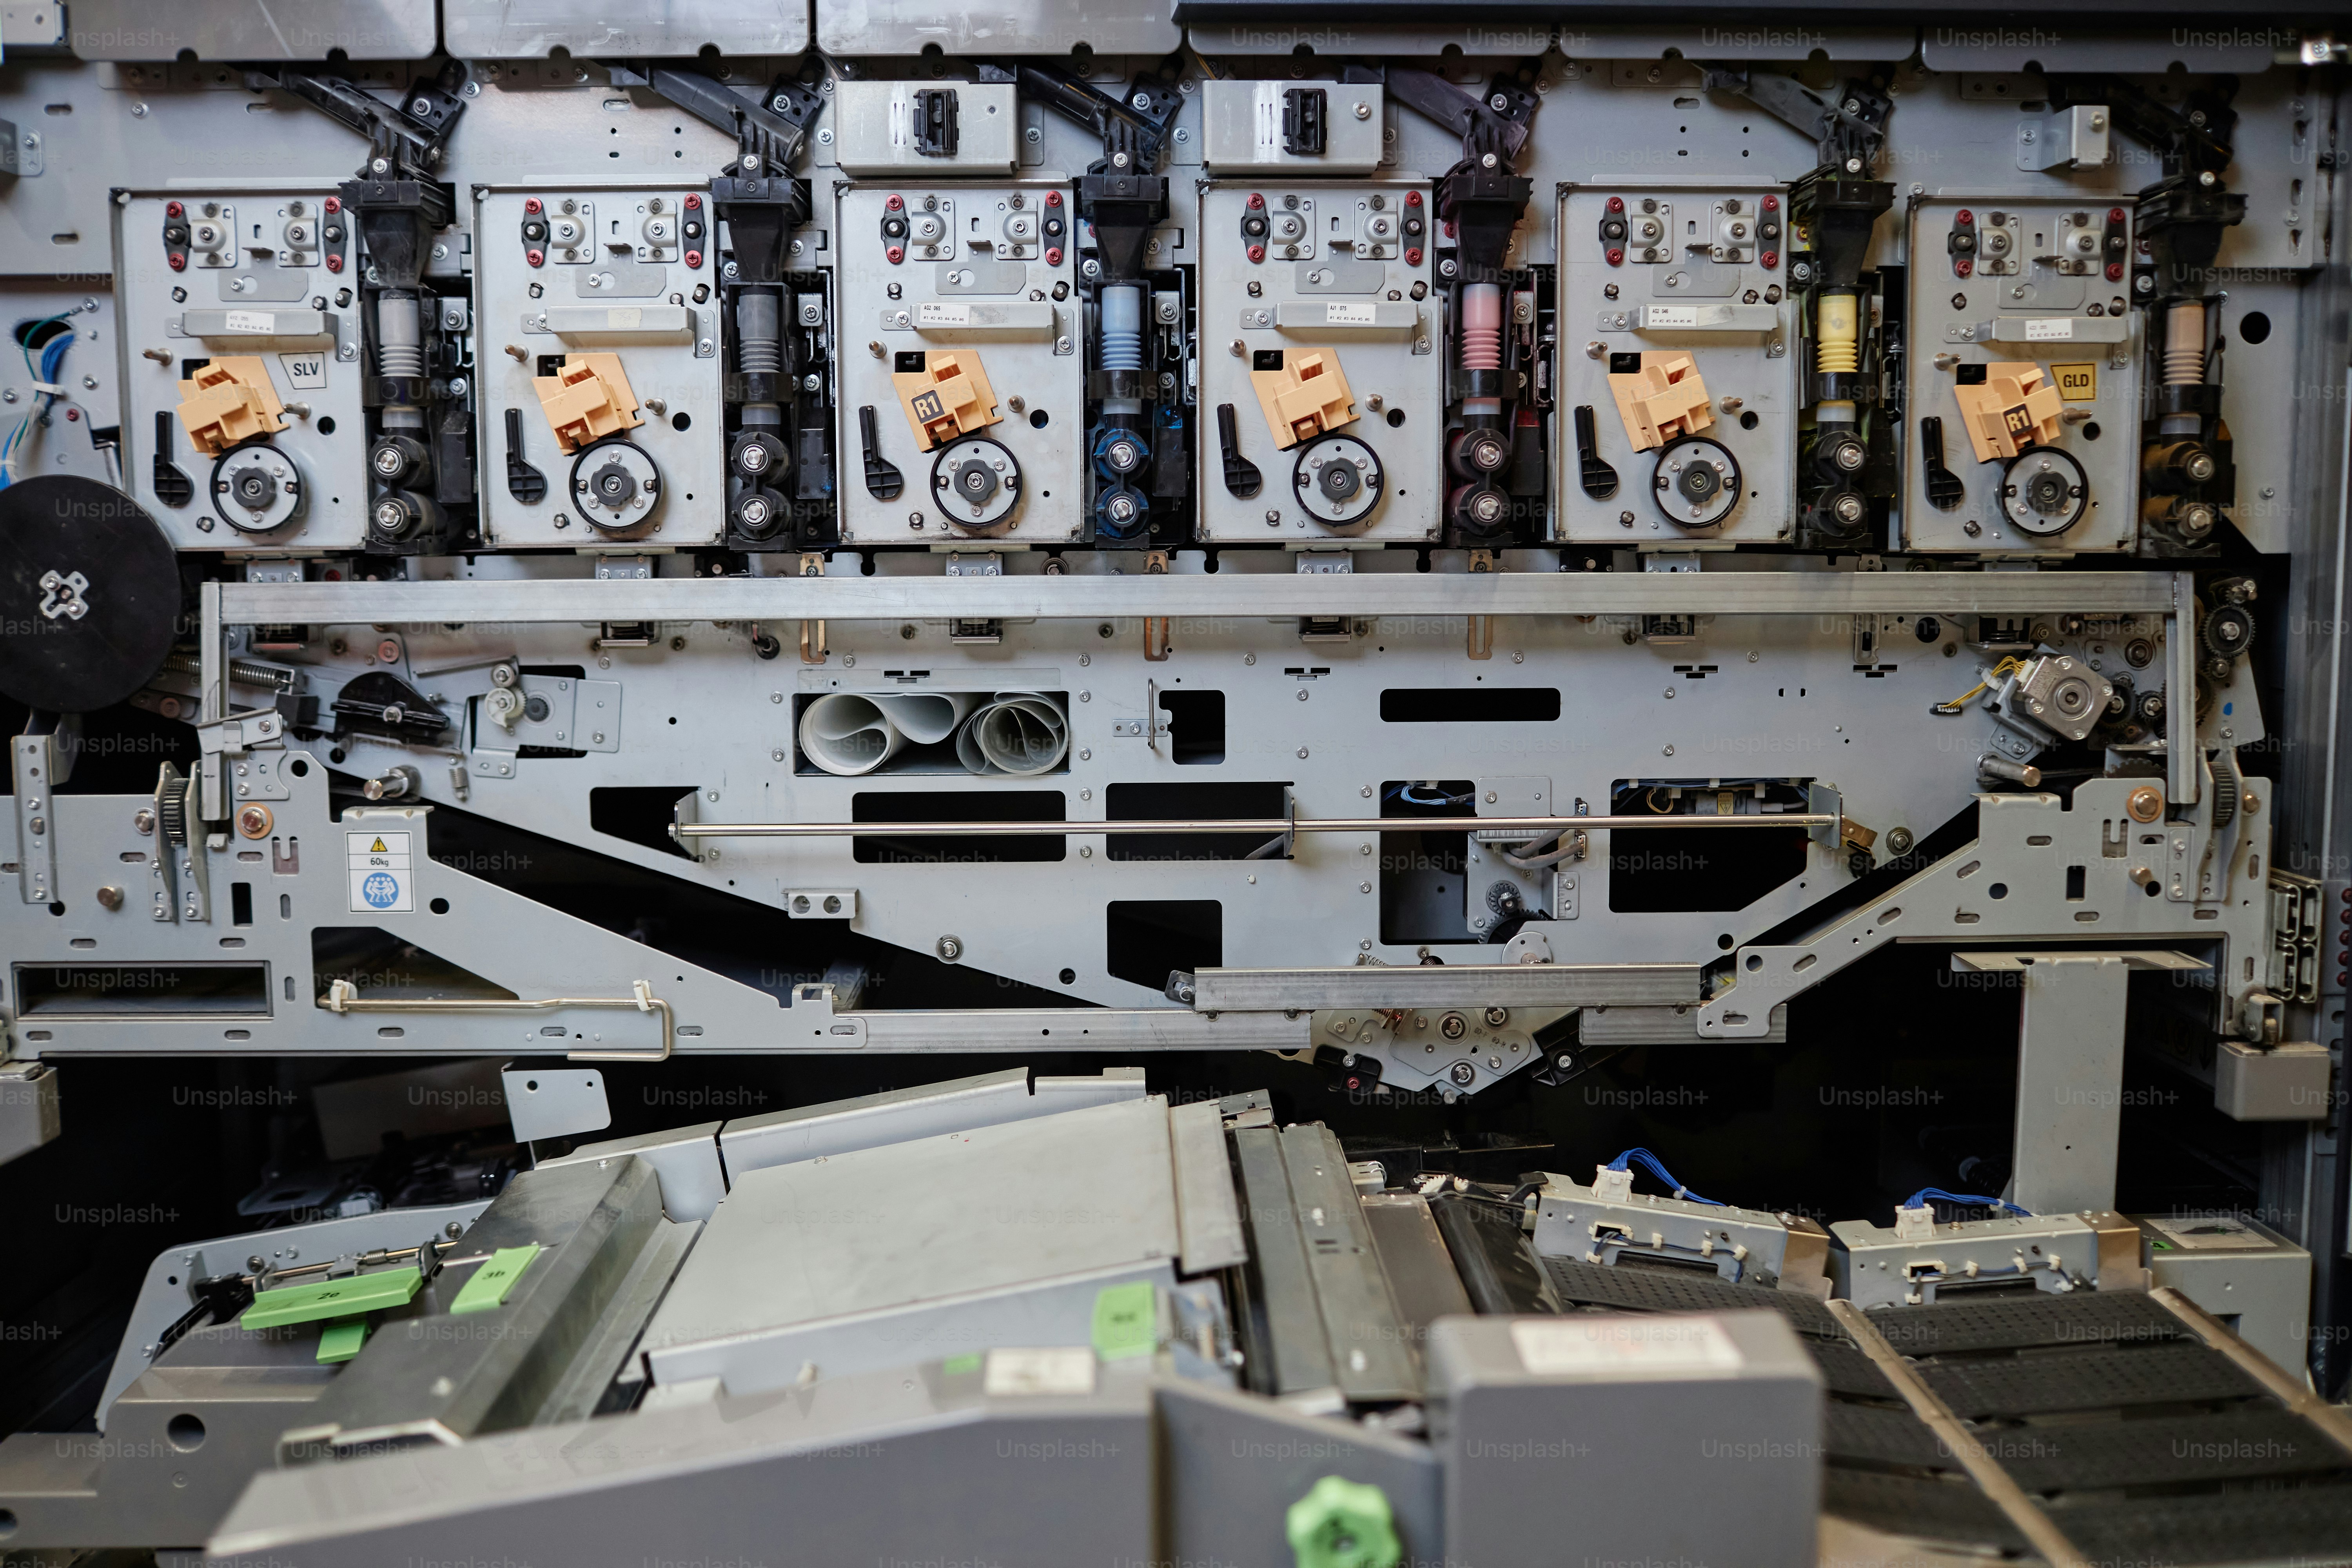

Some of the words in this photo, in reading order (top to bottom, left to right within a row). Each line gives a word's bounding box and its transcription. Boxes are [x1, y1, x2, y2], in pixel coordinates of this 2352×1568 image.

[293, 362, 319, 376] SLV
[2063, 374, 2089, 388] GLD
[915, 395, 939, 419] R1
[2005, 409, 2030, 432] R1
[370, 857, 389, 867] 60kg
[482, 1270, 506, 1279] 3b
